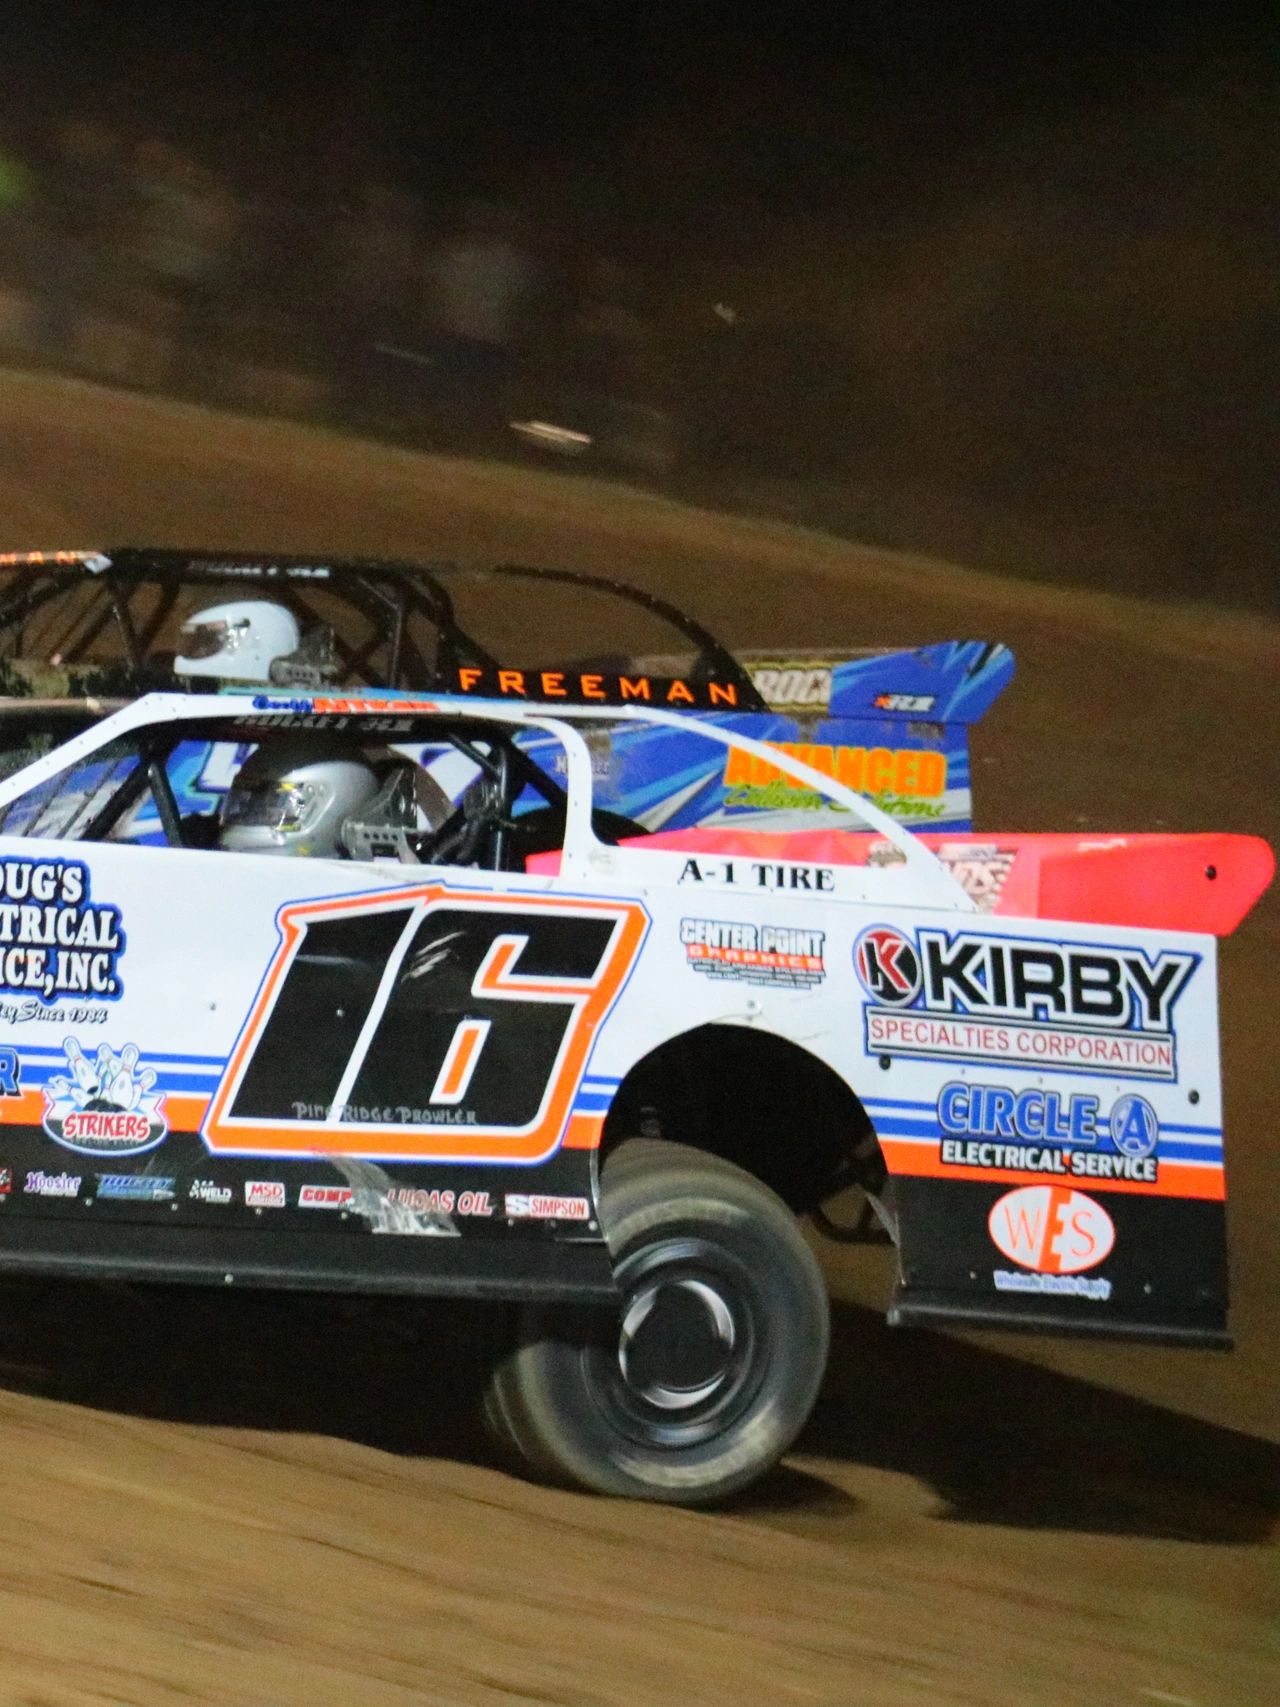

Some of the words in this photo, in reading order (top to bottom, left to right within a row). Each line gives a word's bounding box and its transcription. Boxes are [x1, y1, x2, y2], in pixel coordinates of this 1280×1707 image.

[459, 667, 737, 705] FREEMAN
[679, 858, 737, 884] A-1
[751, 863, 836, 892] TIRE
[680, 918, 758, 950] CENTER
[762, 925, 825, 957] POINT
[920, 933, 1190, 1026] KIRBY
[18, 1000, 65, 1023] Since
[215, 895, 635, 1140] 16
[871, 1019, 1010, 1051] SPECIALTIES
[1016, 1031, 1172, 1066] CORPORATION
[63, 1112, 150, 1140] STRIKERS
[936, 1081, 1101, 1145] CIRCLE
[941, 1140, 1066, 1174] ELECTRICAL
[1072, 1151, 1158, 1182] SERVICE
[24, 1171, 82, 1193] Hoosier
[199, 1186, 233, 1200] WELD
[251, 1184, 283, 1197] MSD
[457, 1191, 494, 1216] OIL
[530, 1198, 586, 1217] SIMPSON
[1003, 1187, 1096, 1272] WES
